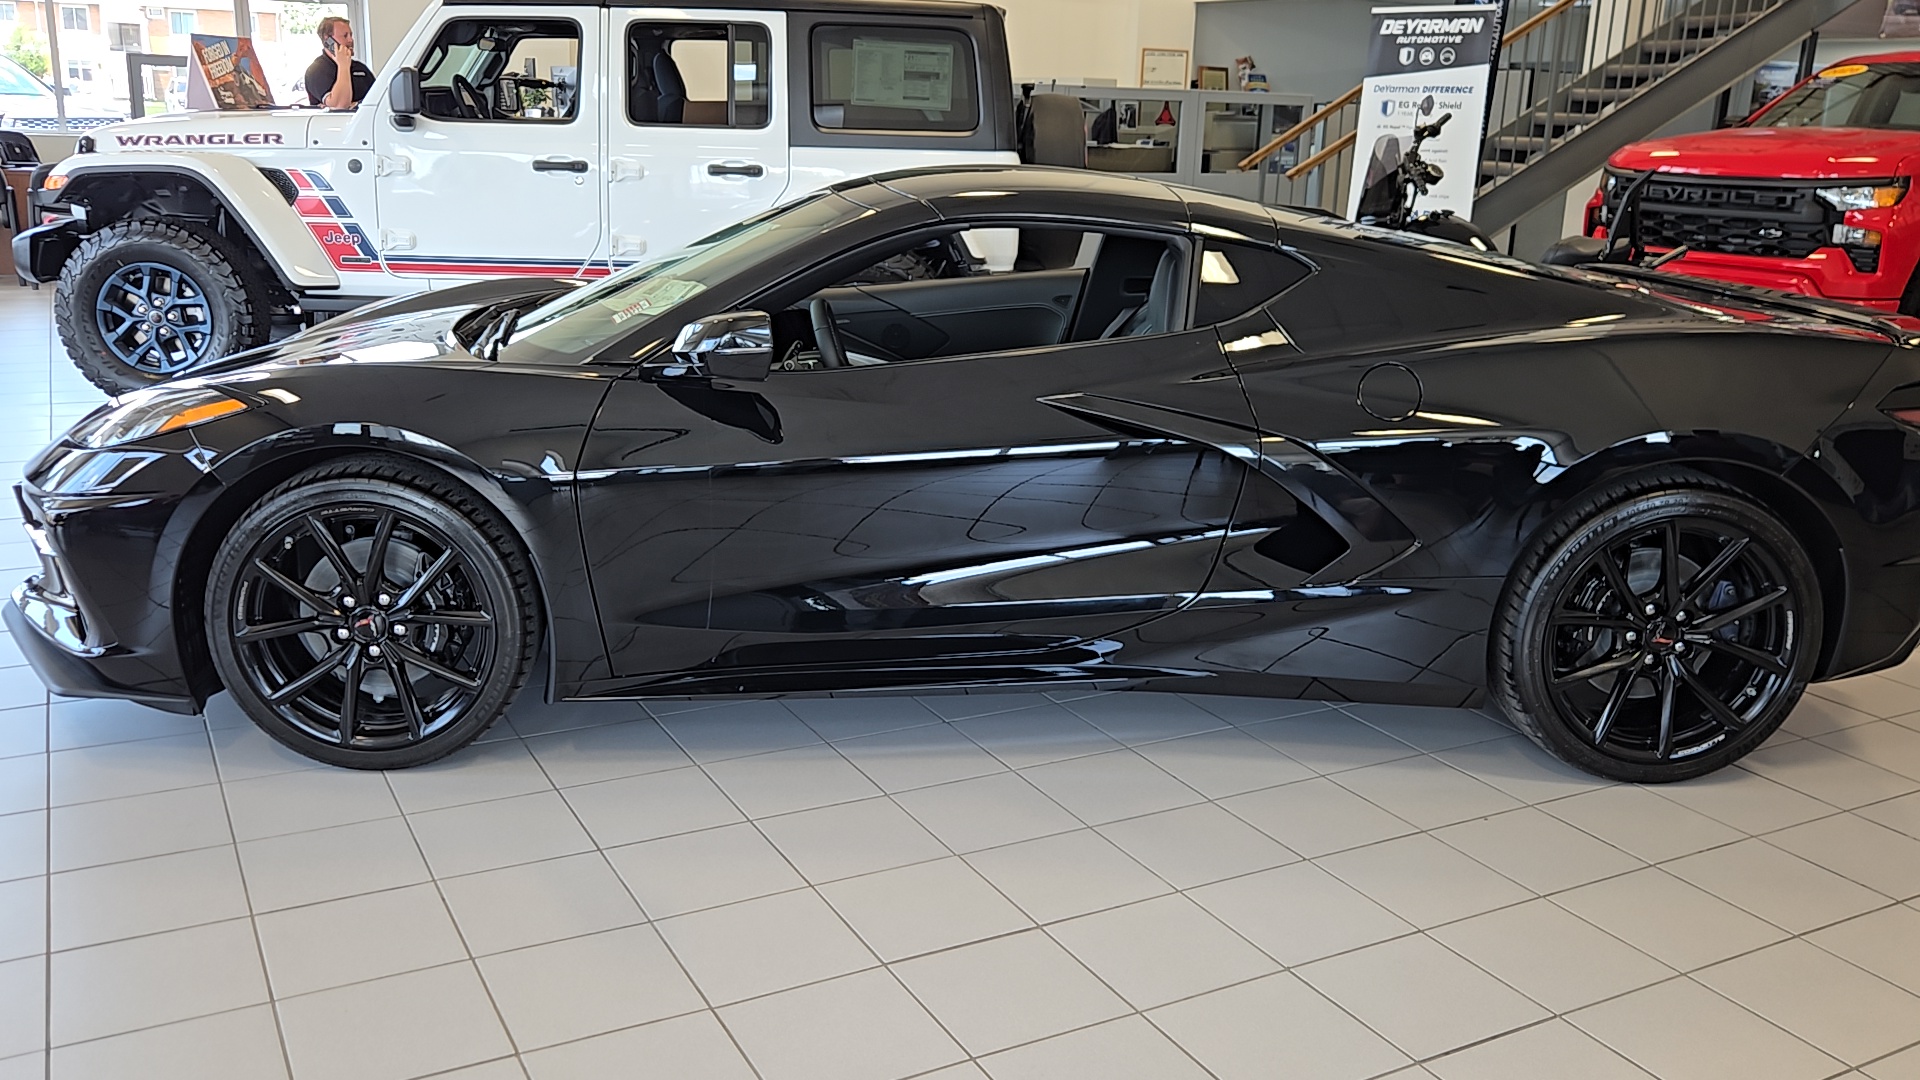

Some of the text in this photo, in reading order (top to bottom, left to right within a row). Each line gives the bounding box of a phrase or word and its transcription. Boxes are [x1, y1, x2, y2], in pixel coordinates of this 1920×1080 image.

[1379, 17, 1485, 35] DEYARMAN
[1396, 35, 1464, 44] AUTOMOTIVE
[1373, 85, 1475, 94] DeYarman DIFFERENCE
[1398, 101, 1410, 109] EG
[1438, 101, 1462, 110] Shield
[115, 133, 285, 146] WRANGLER
[1618, 182, 1804, 208] CEVROLET
[324, 231, 361, 246] Jeep
